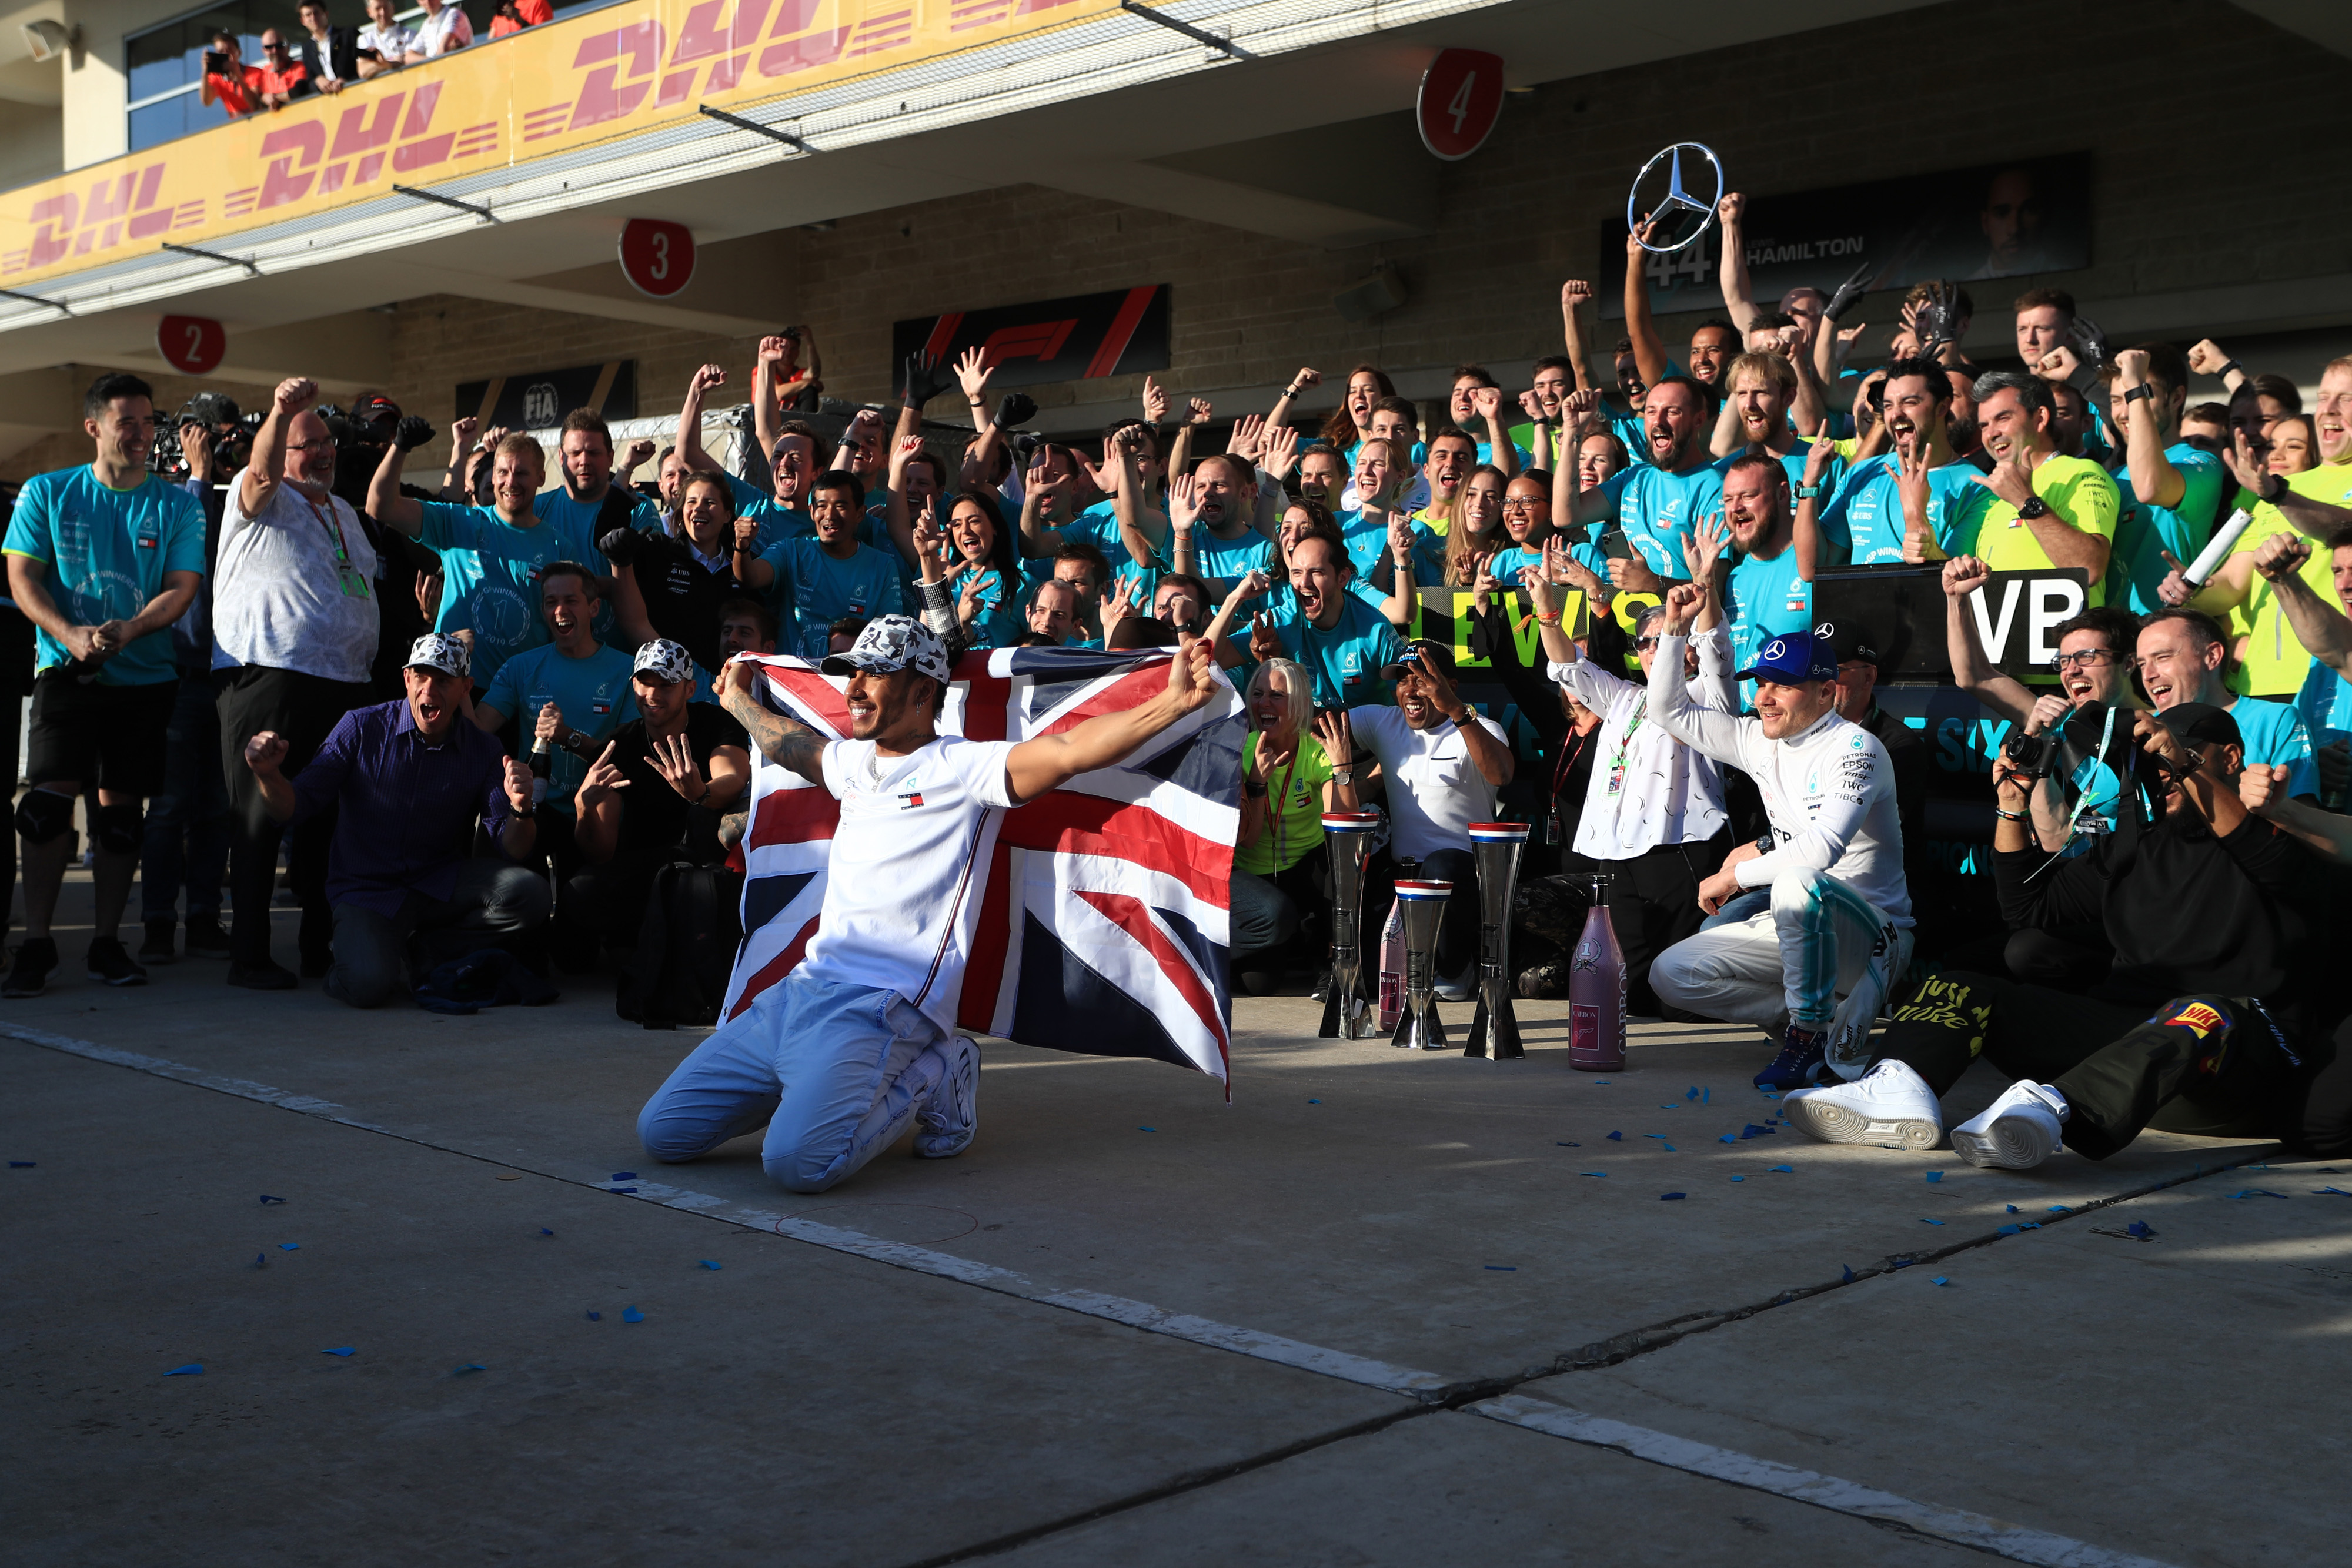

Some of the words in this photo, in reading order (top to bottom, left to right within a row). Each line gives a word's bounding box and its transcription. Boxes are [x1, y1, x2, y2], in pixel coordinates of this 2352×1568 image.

[568, 0, 853, 131] DHL
[1448, 71, 1476, 135] 4
[257, 80, 457, 210] DHL
[27, 162, 175, 270] DHL
[651, 232, 669, 280] 3
[1646, 228, 1712, 287] 44
[1746, 236, 1863, 266] HAMILTON
[185, 325, 202, 363] 2
[525, 392, 555, 420] FIA
[1866, 550, 1877, 563] GP
[1876, 546, 1904, 560] WINNE
[98, 569, 136, 589] WINNERS
[492, 586, 526, 607] WINNERS
[1970, 578, 2085, 665] VB
[484, 633, 506, 646] 2019
[1743, 656, 1754, 668] GP
[1842, 752, 1877, 761] PETRONAS
[1936, 717, 2013, 773] SIX
[1843, 761, 1875, 772] EPSON
[1844, 772, 1872, 781] BOSE
[560, 781, 580, 792] 2019
[1841, 780, 1865, 792] IWC
[1834, 792, 1864, 805] TIBCO
[1581, 942, 1591, 956] 1
[1913, 974, 1972, 1009] just
[876, 1005, 885, 1029] PIECES
[1573, 1010, 1596, 1019] CARBON
[1618, 962, 1627, 1055] CARBON
[2179, 1007, 2220, 1027] NIK
[1851, 1024, 1864, 1056] EPSO
